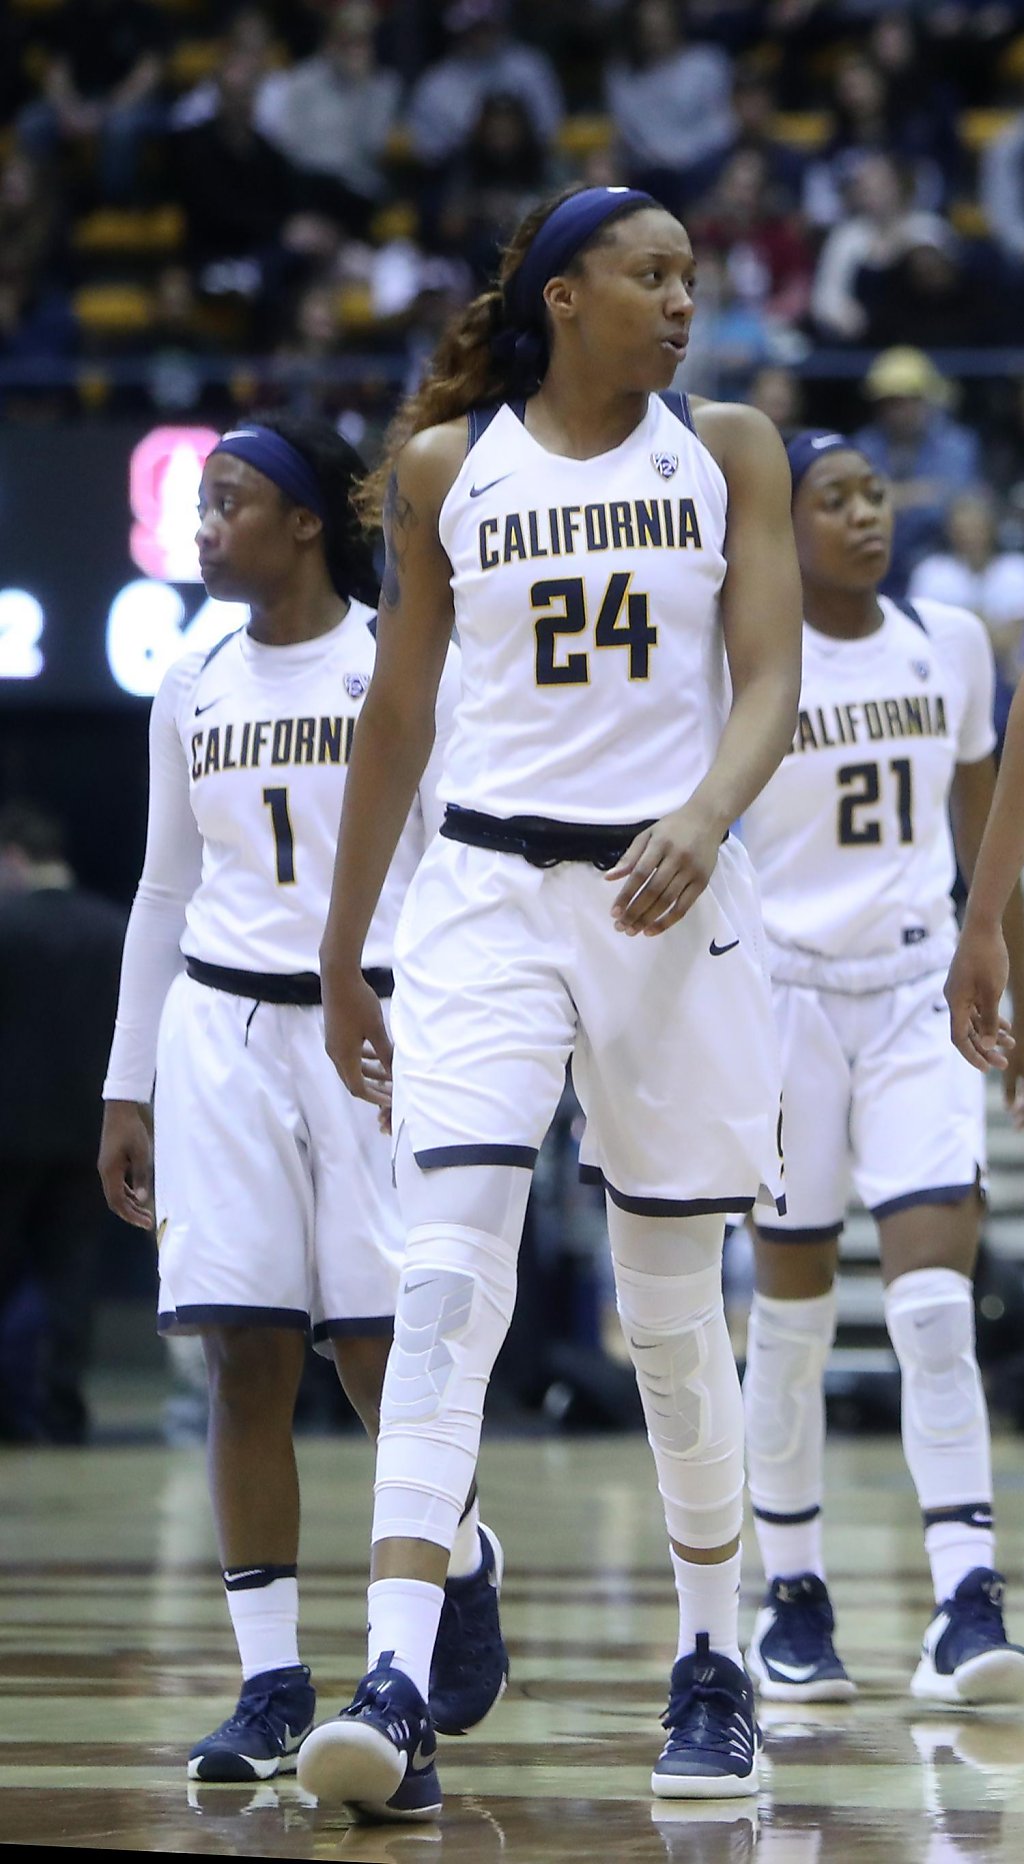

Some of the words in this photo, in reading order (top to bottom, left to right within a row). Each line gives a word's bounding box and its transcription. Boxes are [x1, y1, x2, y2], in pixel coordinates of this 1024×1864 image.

[478, 498, 703, 572] CALIFORNIA
[530, 571, 658, 686] 24
[190, 716, 356, 783] CALIFORNI
[788, 695, 948, 755] ALIFORNIA
[262, 786, 298, 887] 1
[837, 755, 914, 847] 21
